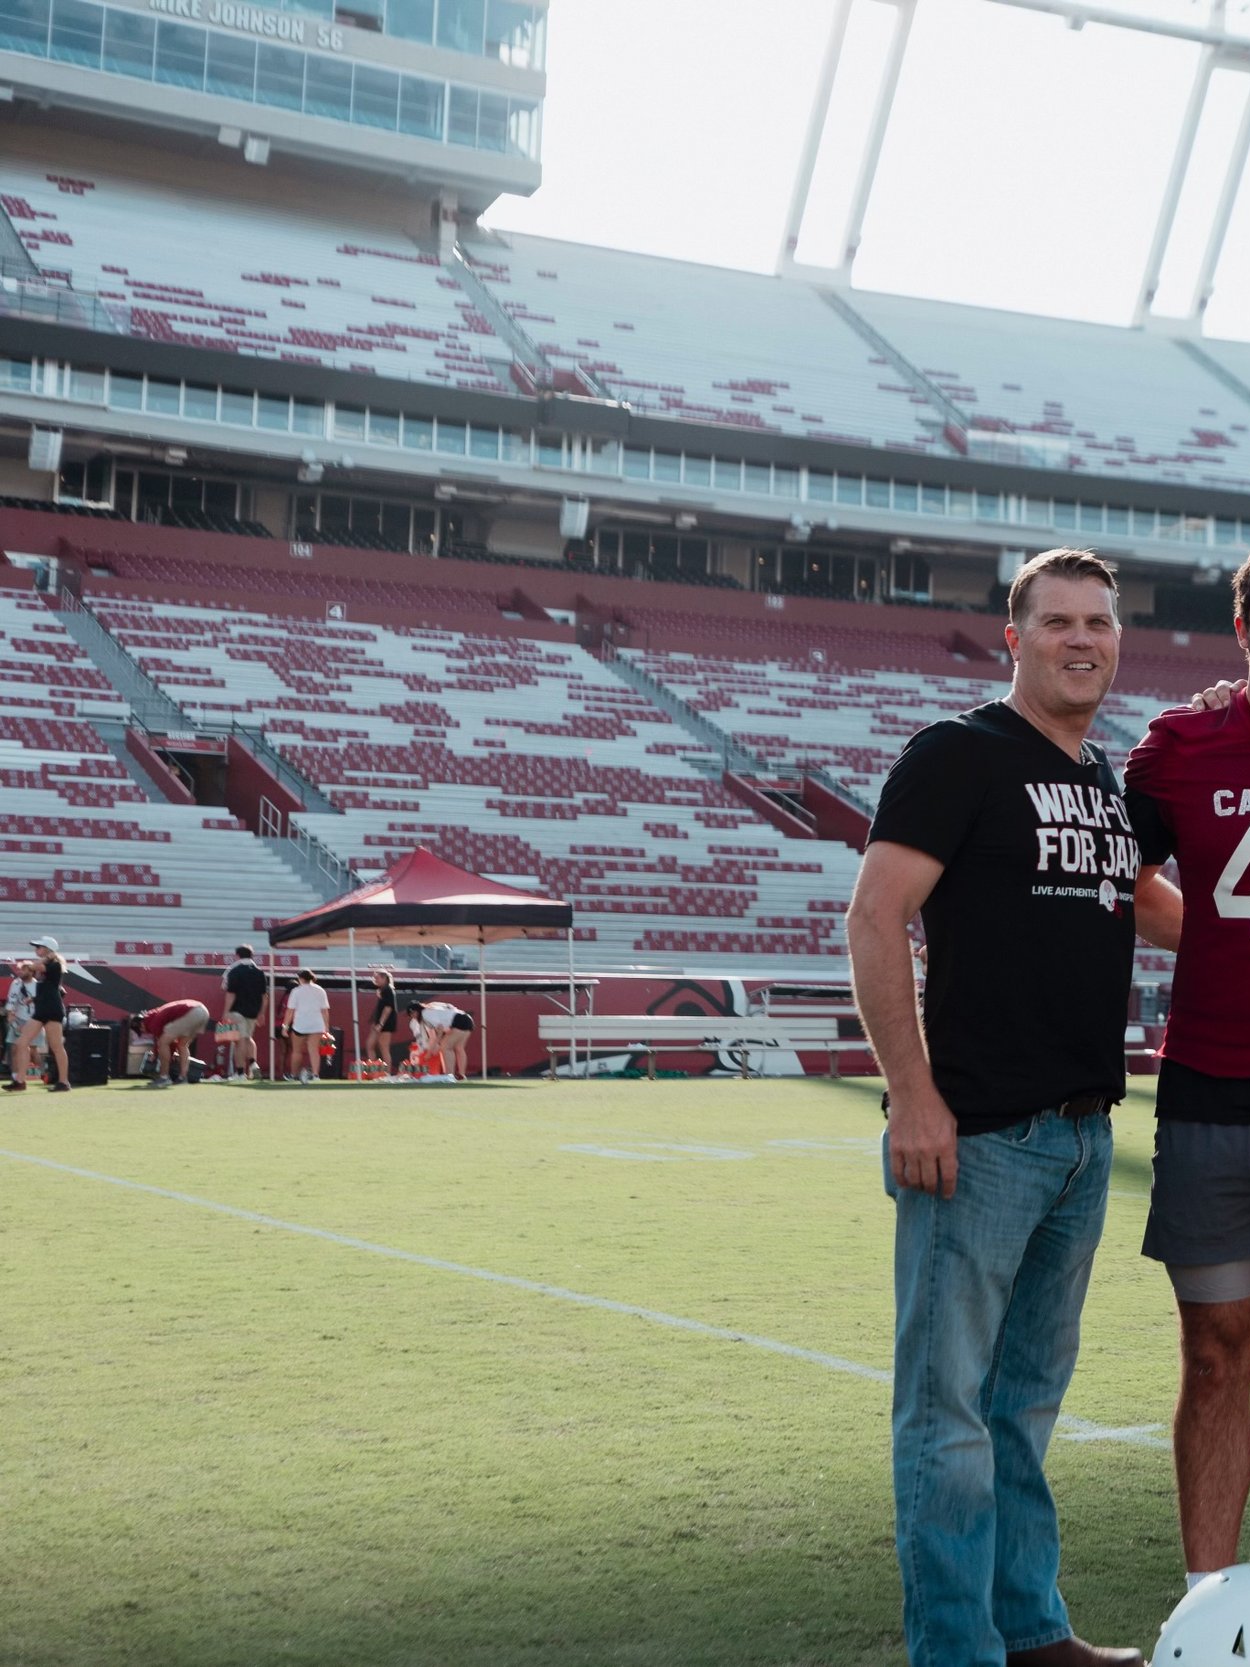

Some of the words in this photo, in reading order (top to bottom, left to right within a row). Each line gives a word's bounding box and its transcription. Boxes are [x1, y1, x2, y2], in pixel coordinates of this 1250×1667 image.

[209, 0, 305, 44] JOHNSON
[328, 604, 344, 619] 4
[1024, 783, 1134, 834] WALK-O
[1036, 827, 1098, 874] FOR
[1102, 834, 1142, 880] JAK
[1032, 885, 1054, 896] LIVE
[1054, 886, 1098, 898] AUTHENTIC
